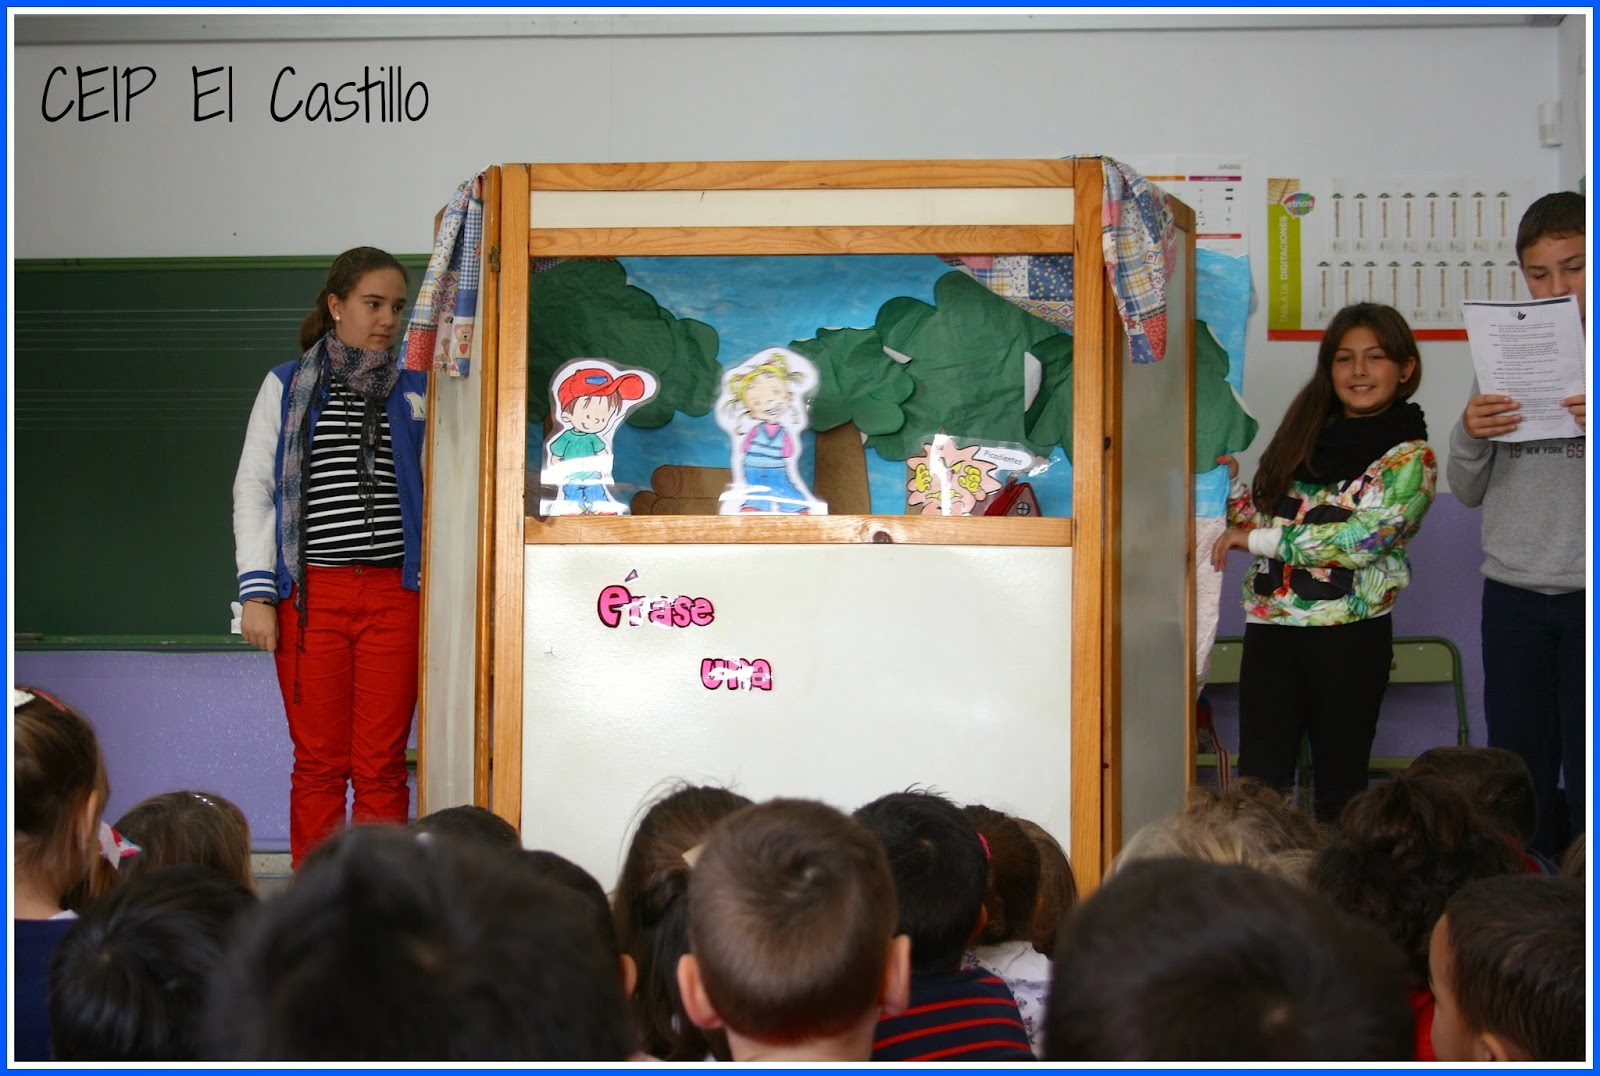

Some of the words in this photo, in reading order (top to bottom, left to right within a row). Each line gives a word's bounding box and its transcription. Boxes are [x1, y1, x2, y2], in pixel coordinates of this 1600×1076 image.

[1286, 199, 1313, 209] etnos
[1280, 216, 1288, 280] DIGITACIONES
[1280, 283, 1288, 294] DE
[1280, 296, 1288, 323] TABLA
[984, 449, 1023, 466] Picodientes
[1509, 443, 1522, 458] 19
[1525, 447, 1540, 455] NEW
[1542, 446, 1564, 455] YORK
[1566, 443, 1585, 459] 69
[700, 657, 773, 691] una
